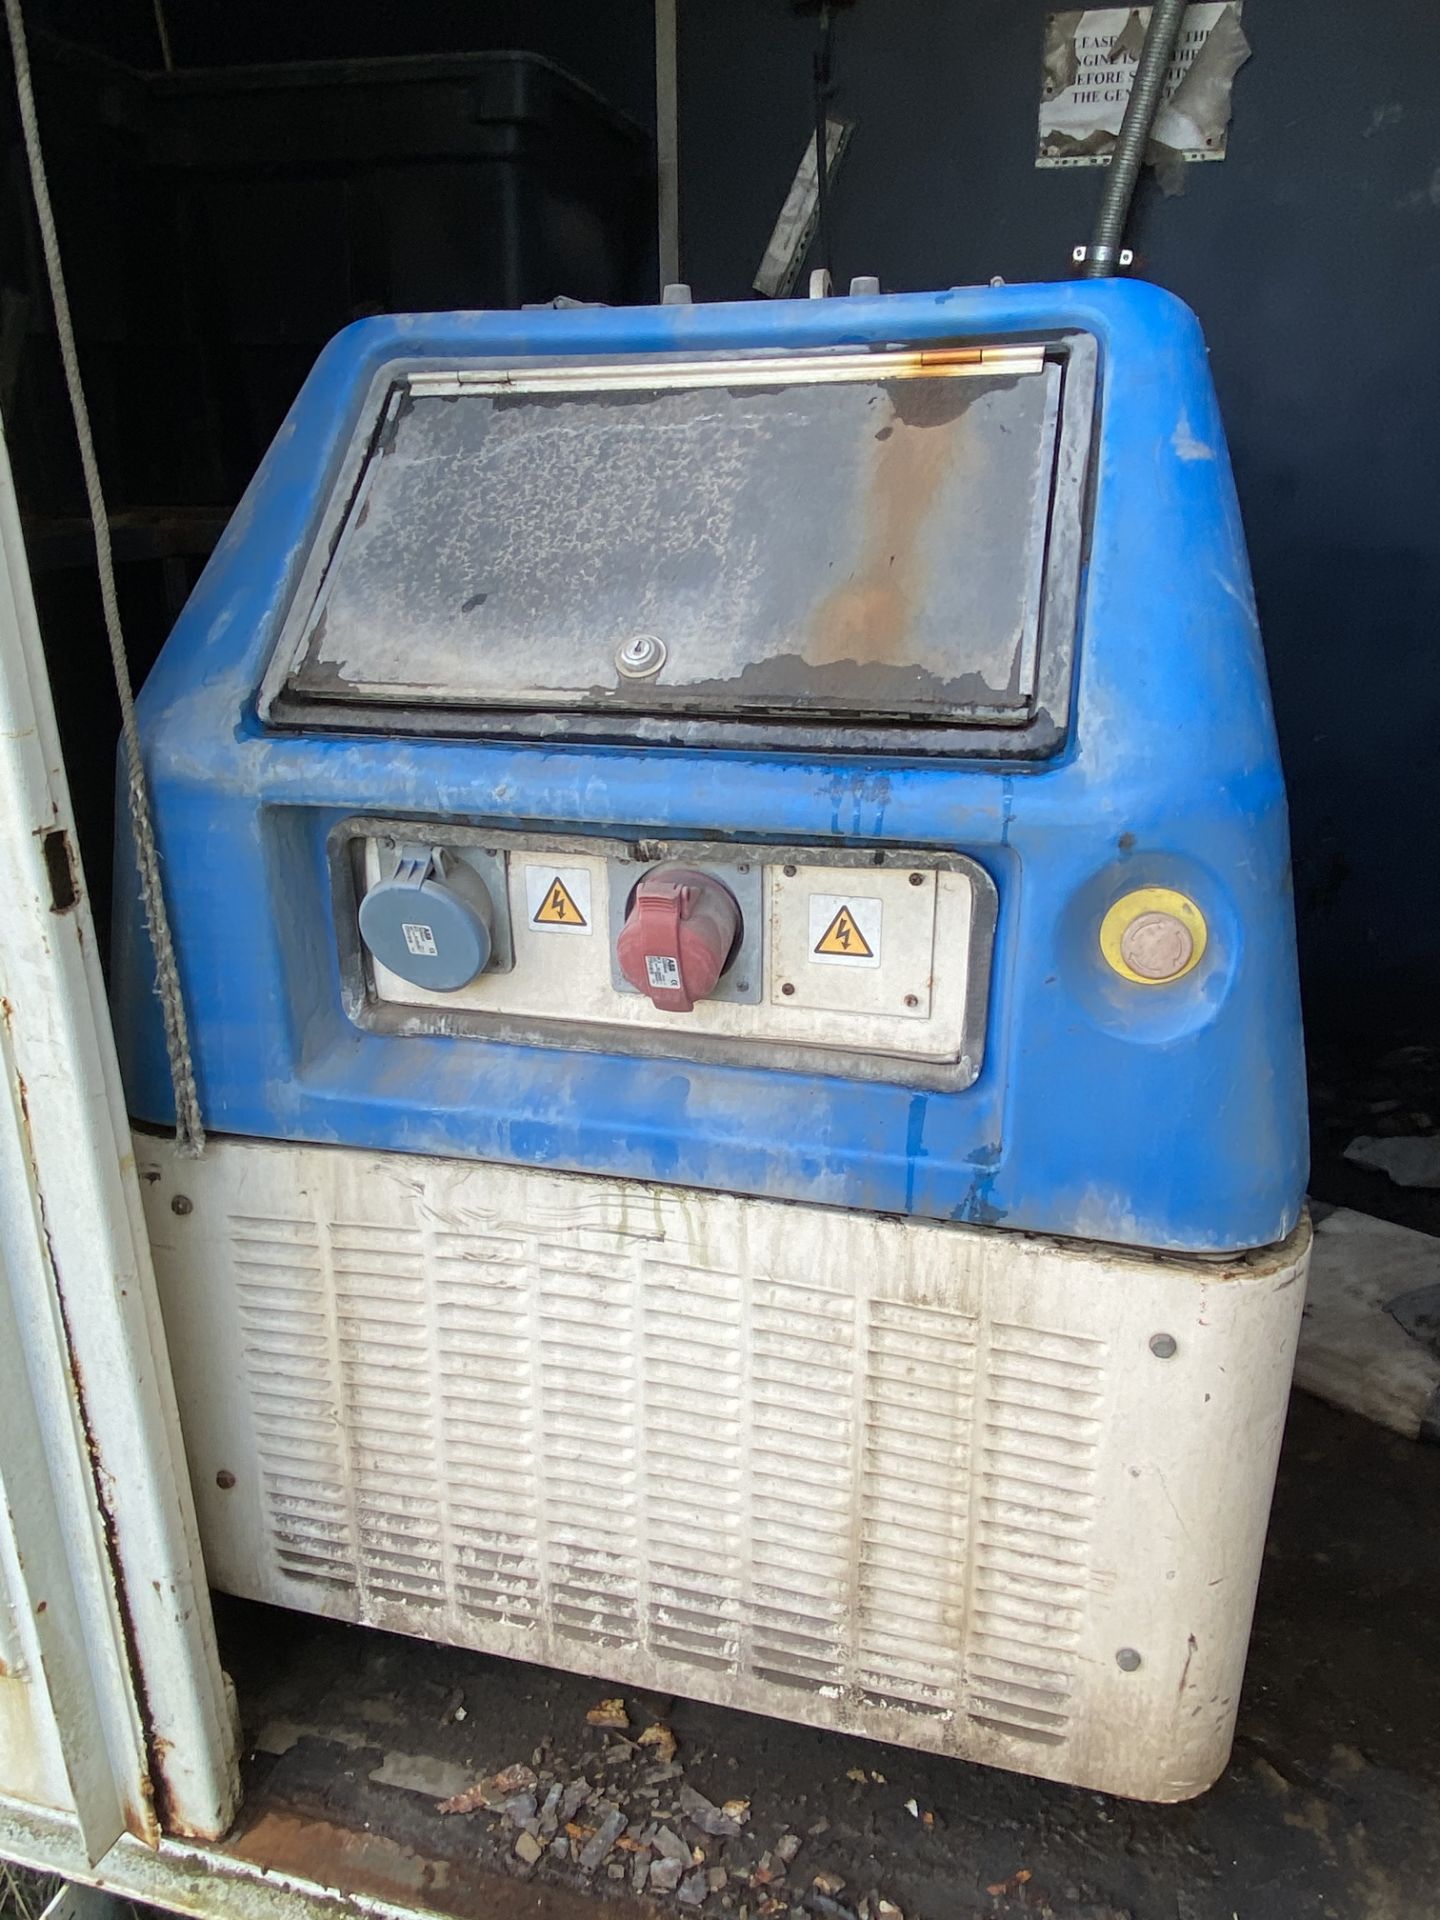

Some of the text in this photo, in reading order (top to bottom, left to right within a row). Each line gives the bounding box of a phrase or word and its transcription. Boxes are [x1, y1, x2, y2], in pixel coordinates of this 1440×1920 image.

[1073, 35, 1118, 49] LEASE
[1075, 53, 1118, 67] NGINE
[1074, 71, 1123, 86] EFORE
[1072, 91, 1100, 104] THE
